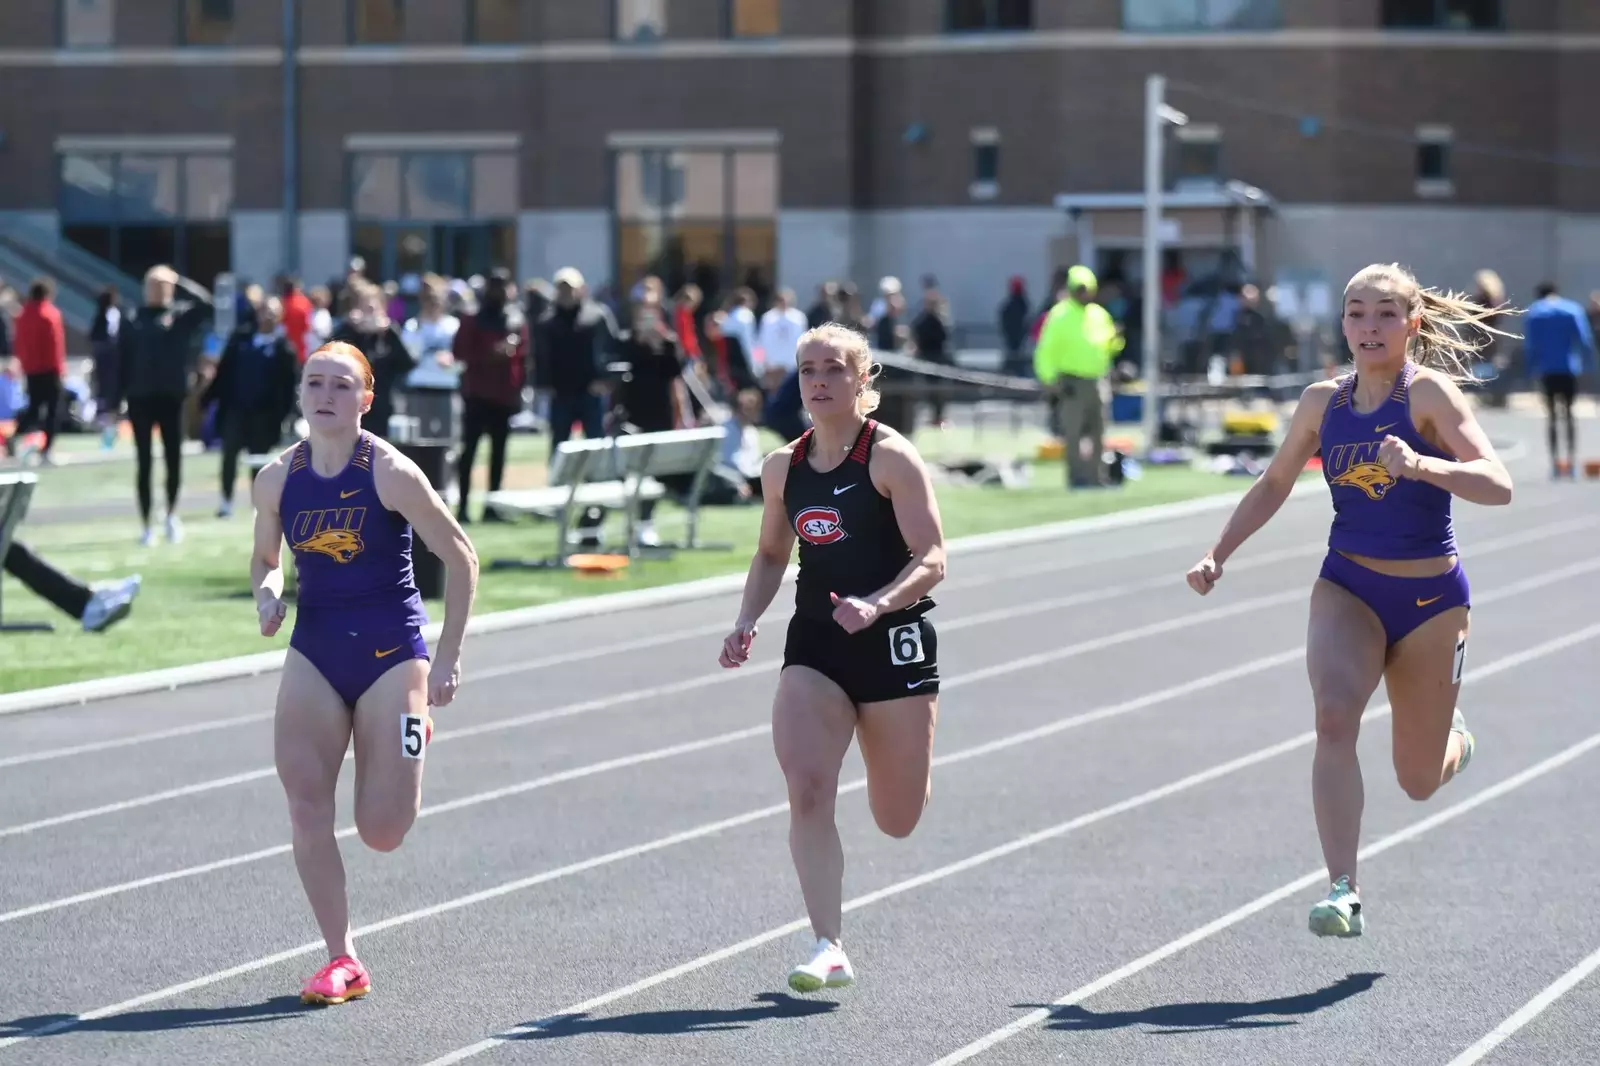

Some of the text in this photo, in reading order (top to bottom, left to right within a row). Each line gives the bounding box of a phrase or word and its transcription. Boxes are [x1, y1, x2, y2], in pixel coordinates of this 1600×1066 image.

[1327, 441, 1383, 479] UN
[292, 507, 367, 545] UNI
[893, 626, 918, 662] 6
[405, 717, 422, 756] 5
